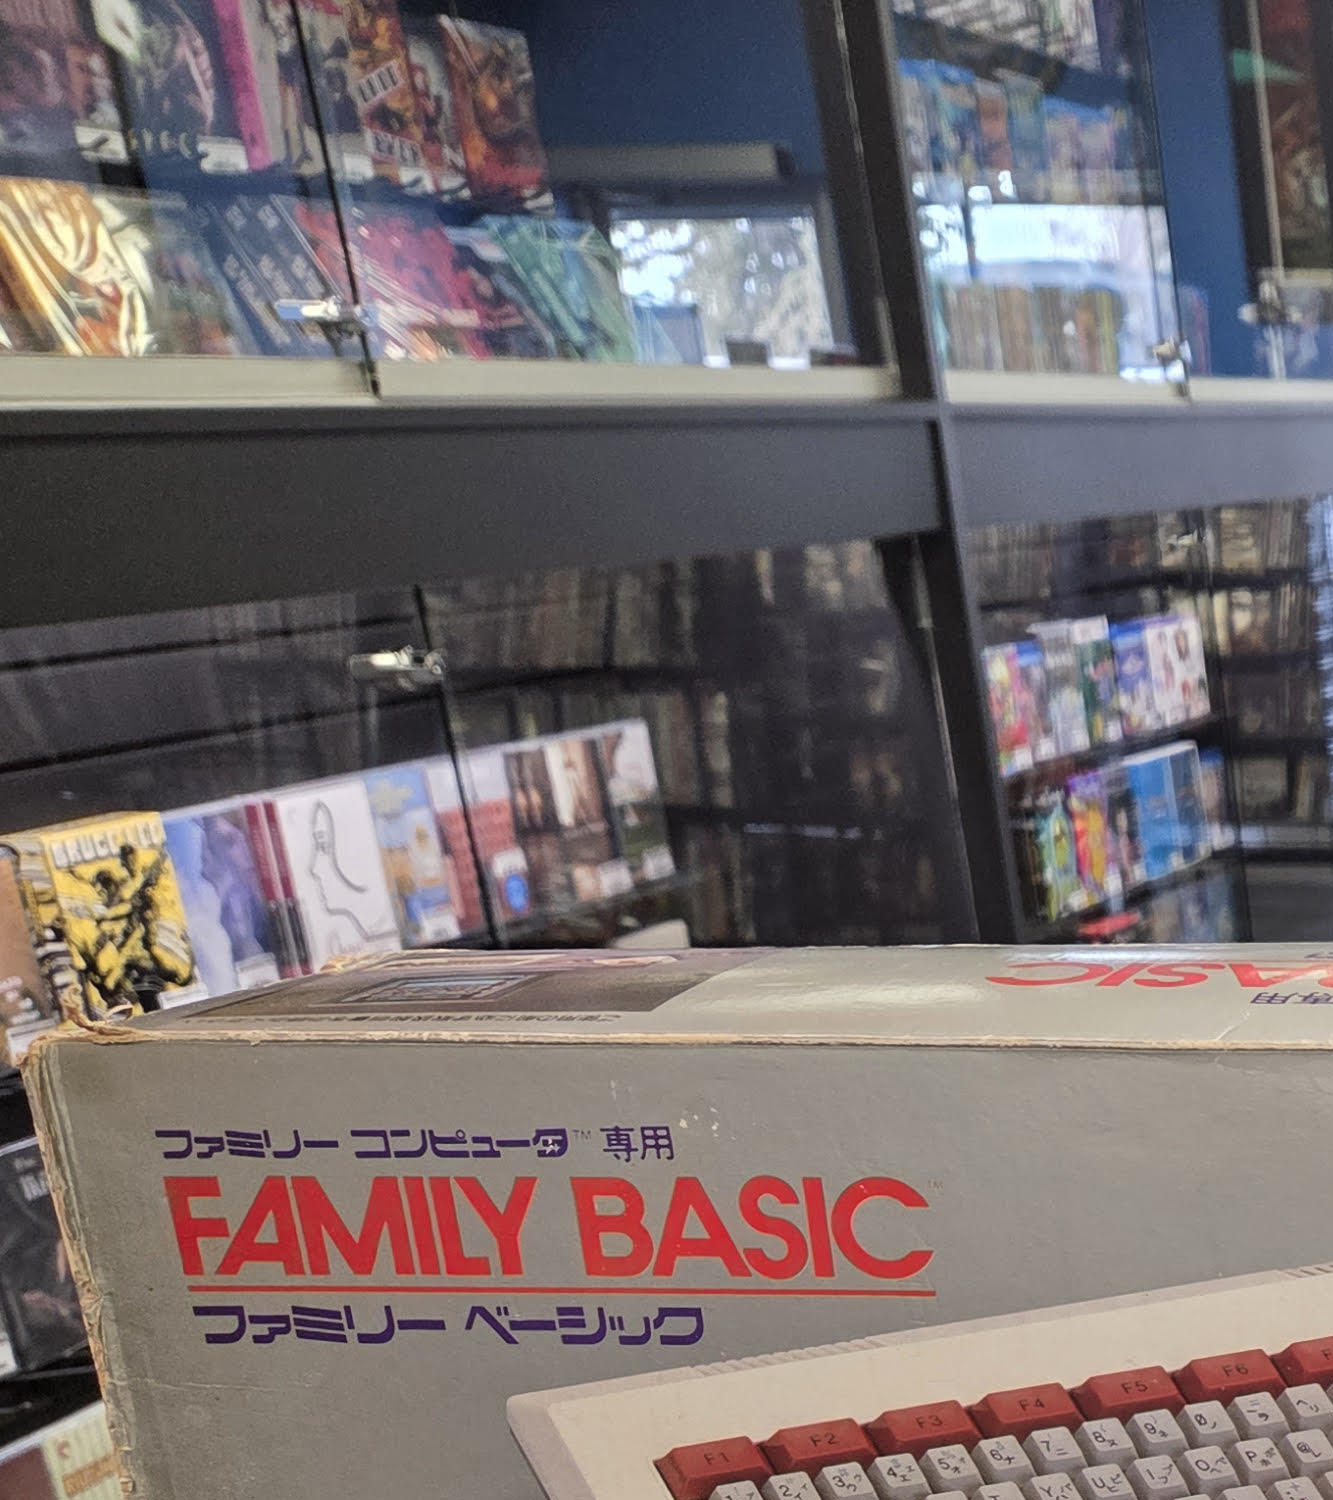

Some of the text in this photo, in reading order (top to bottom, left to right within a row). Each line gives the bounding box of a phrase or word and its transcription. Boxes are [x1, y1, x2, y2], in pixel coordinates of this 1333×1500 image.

[155, 1130, 339, 1159] ファミリー
[600, 1126, 675, 1163] 専用
[163, 1176, 538, 1275] FAMILY
[193, 1305, 705, 1345] ファミリー ベーシック
[1221, 1364, 1249, 1378] F6
[1120, 1379, 1148, 1394] F5
[1018, 1397, 1046, 1412] F4
[915, 1414, 944, 1430] F3
[809, 1431, 837, 1448] F2
[703, 1451, 731, 1465] F1
